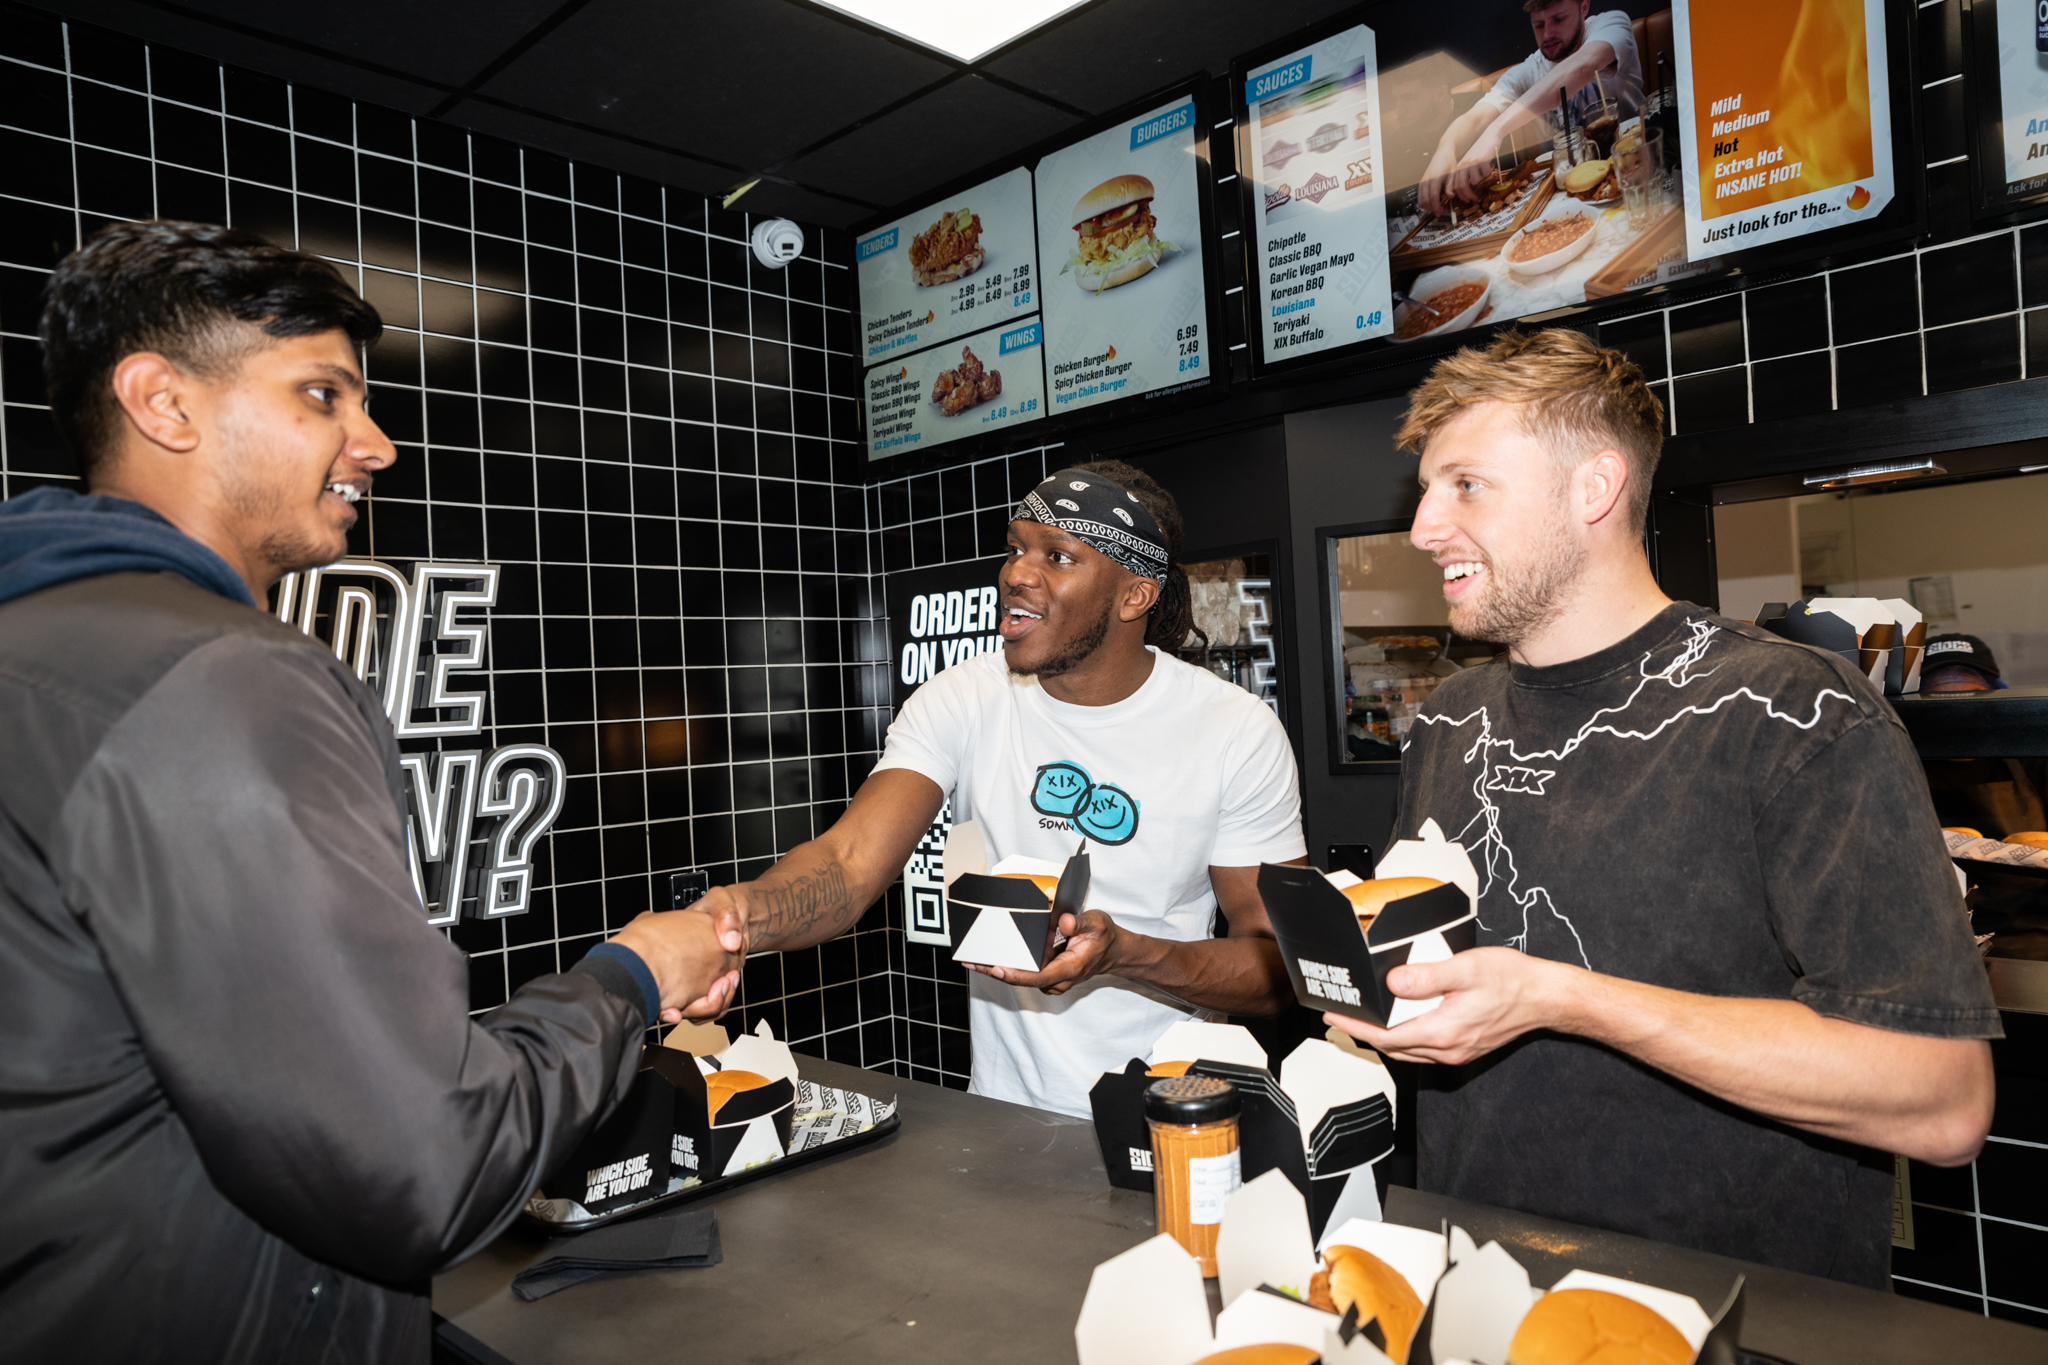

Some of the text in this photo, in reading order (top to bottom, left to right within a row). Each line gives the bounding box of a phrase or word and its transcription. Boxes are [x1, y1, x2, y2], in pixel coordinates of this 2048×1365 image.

[1256, 64, 1304, 96] SAUCES
[1710, 93, 1741, 117] Mild
[1137, 110, 1187, 143] BURGERS
[1712, 110, 1770, 138] Medium
[1714, 137, 1739, 157] Hot
[1714, 146, 1783, 178] Extra Hot
[1296, 176, 1338, 199] LOUISIANA
[1716, 162, 1802, 199] INSANE HOT!
[2007, 179, 2047, 195] Ask for
[1703, 202, 1841, 244] Just look for the...
[862, 233, 894, 256] TENDERS
[1268, 232, 1306, 252] Chipotle
[1269, 242, 1322, 268] Classic BBQ
[1270, 252, 1355, 285] Garlic Vegan Mayo
[959, 283, 975, 299] 2.99
[986, 274, 1002, 289] 5.49
[1013, 264, 1029, 280] 7.99
[1271, 276, 1324, 301] Korean BBQ
[959, 297, 975, 312] 4.99
[986, 288, 1002, 303] 6.49
[1013, 278, 1030, 294] 8.99
[1014, 292, 1031, 307] 8.49
[1272, 297, 1315, 317] Louisiana
[868, 310, 912, 331] Chicken Tenders
[1273, 313, 1310, 333] Teriyaki
[1356, 310, 1382, 329] 0.49
[868, 317, 929, 345] Spicy Chicken Tenders
[1006, 328, 1035, 349] WINGS
[1177, 324, 1198, 341] 6.99
[1274, 328, 1324, 350] XIX Buffalo
[869, 334, 917, 356] Chicken & Waffles
[1179, 340, 1198, 356] 7.49
[1054, 353, 1110, 375] Chicken Burger
[1179, 355, 1199, 372] 8.49
[870, 373, 902, 390] Spicy Wings
[1055, 362, 1132, 391] Spicy Chicken Burger
[871, 380, 920, 401] Classic BBQ Wings
[1056, 391, 1077, 404] Vegan
[1078, 385, 1099, 398] Chikn
[1100, 378, 1127, 393] Burger
[872, 393, 921, 414] Korean BBQ Wings
[991, 406, 1006, 420] 6.49
[1020, 398, 1037, 413] 8.99
[872, 408, 916, 426] Louisiana Wings
[873, 422, 913, 438] Teriyaki Wings
[904, 432, 921, 443] Wings
[910, 586, 998, 638] ORDER
[276, 559, 500, 740] DE
[901, 641, 938, 685] ON
[1327, 965, 1353, 988] SIDE
[678, 1134, 694, 1154] SIDE
[684, 1152, 699, 1170] ON?
[1129, 1147, 1154, 1167] SID
[587, 1153, 650, 1187] WHICH SIDE
[584, 1168, 653, 1204] ARE YOU ON?
